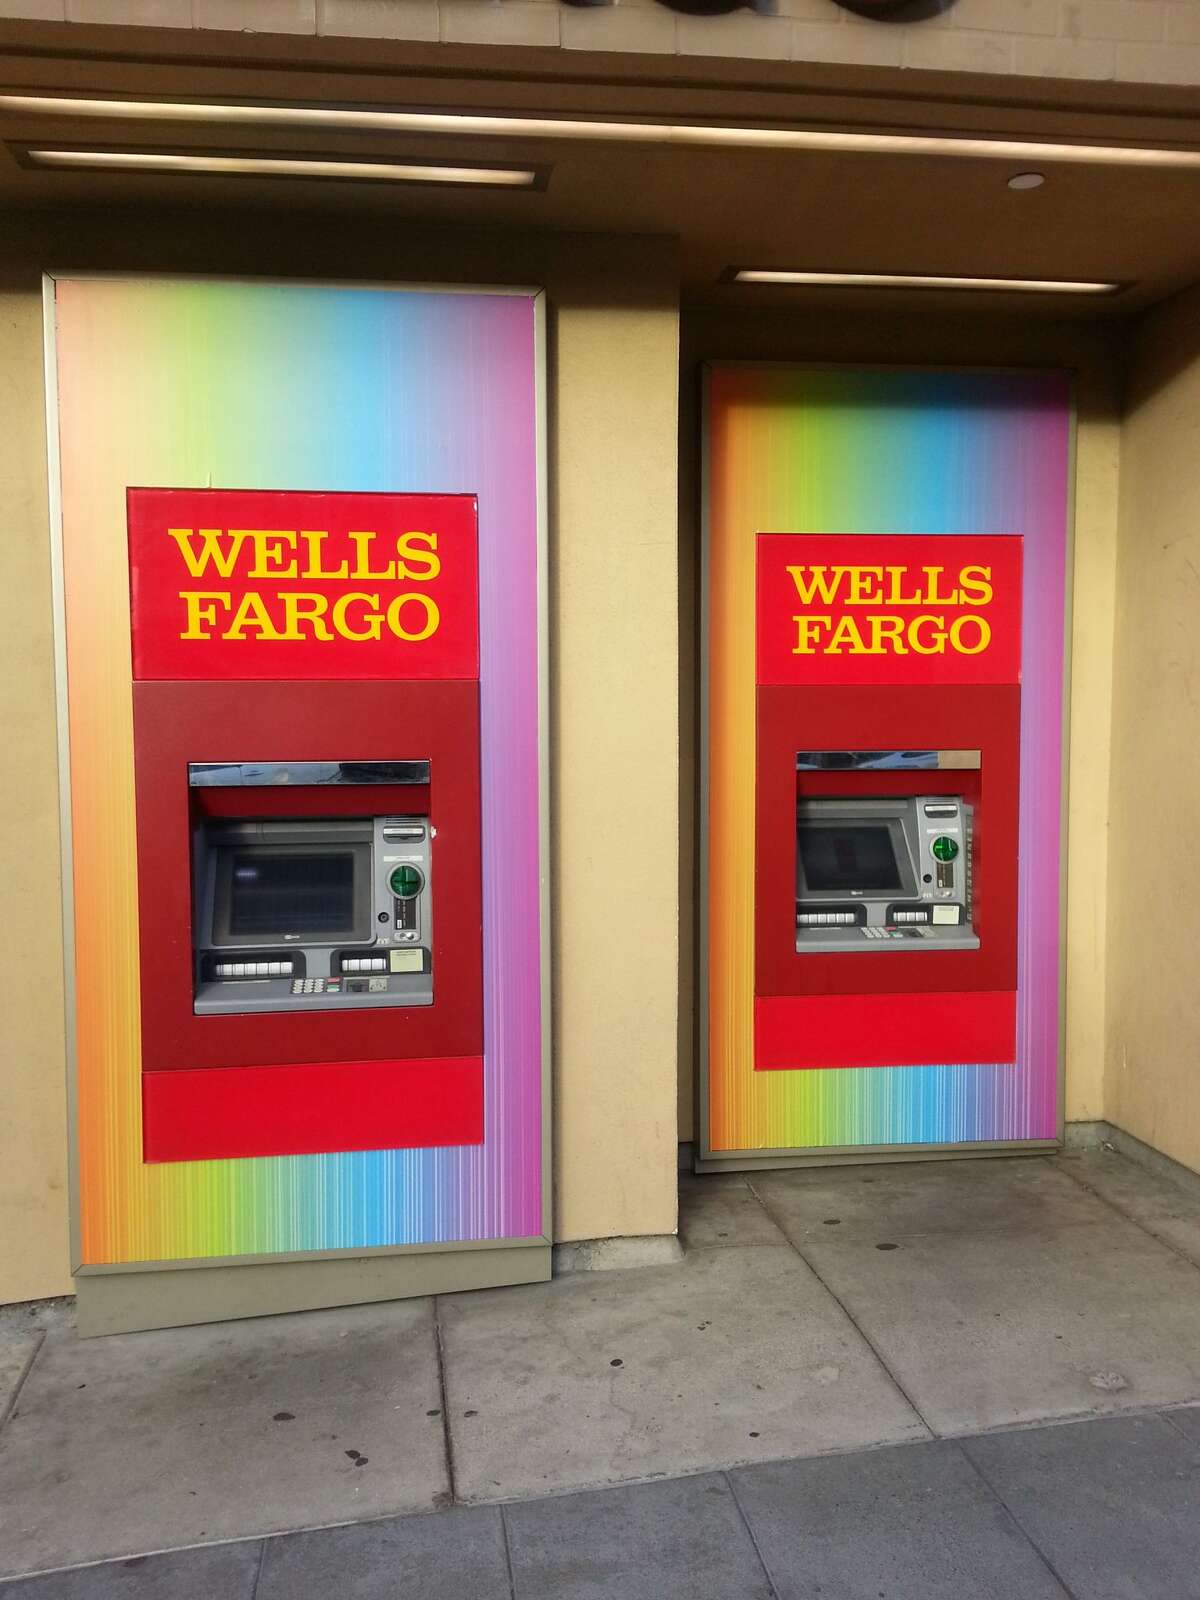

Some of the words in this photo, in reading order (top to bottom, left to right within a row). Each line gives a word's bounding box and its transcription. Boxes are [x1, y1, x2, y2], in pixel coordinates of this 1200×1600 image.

[168, 529, 440, 581] WELLS
[787, 566, 993, 606] WELLS
[179, 592, 440, 642] FARGO
[793, 615, 992, 655] FARGO
